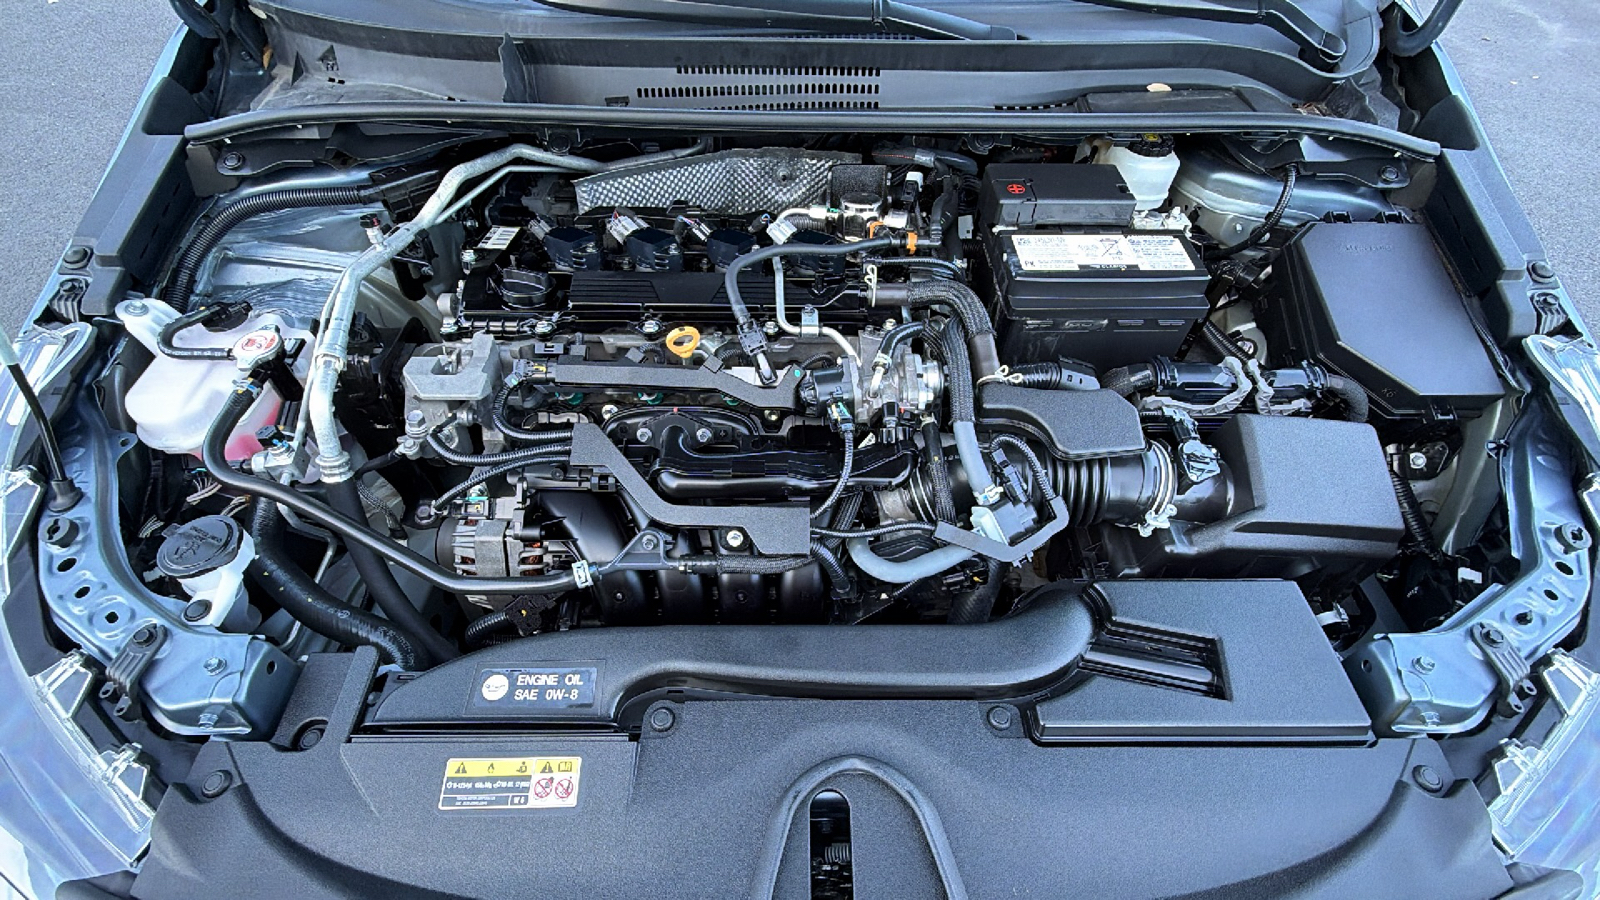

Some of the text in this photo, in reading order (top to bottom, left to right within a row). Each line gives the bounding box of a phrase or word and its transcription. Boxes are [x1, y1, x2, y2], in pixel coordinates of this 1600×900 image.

[516, 674, 583, 686] ENGINE OIL
[514, 689, 539, 700] SAE
[545, 689, 579, 700] 0W-8
